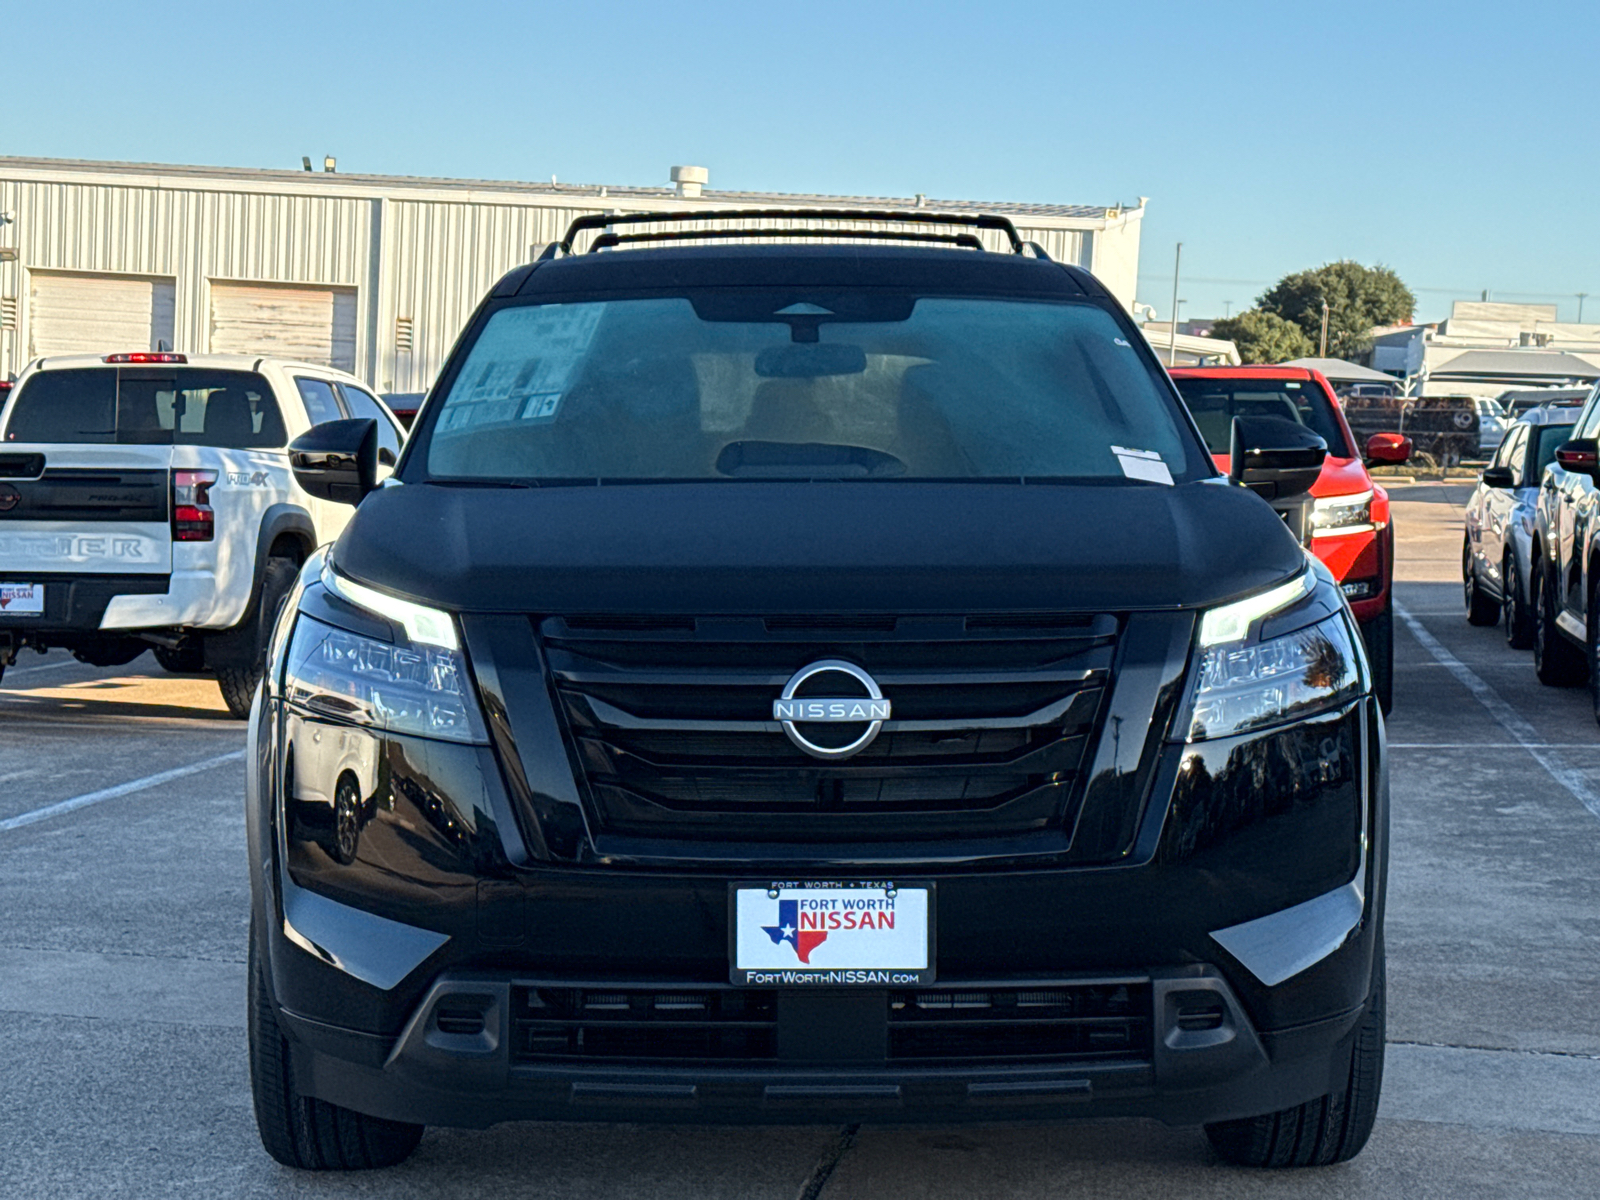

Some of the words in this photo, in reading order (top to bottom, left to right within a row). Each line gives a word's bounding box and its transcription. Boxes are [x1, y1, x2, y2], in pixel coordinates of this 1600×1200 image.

[776, 703, 887, 718] NISSAN
[771, 881, 800, 889] FORT
[804, 881, 843, 889] WORTH
[859, 881, 894, 889] TEXAS
[800, 899, 838, 910] FORT
[842, 899, 895, 910] WORTH
[800, 911, 895, 930] NISSAN
